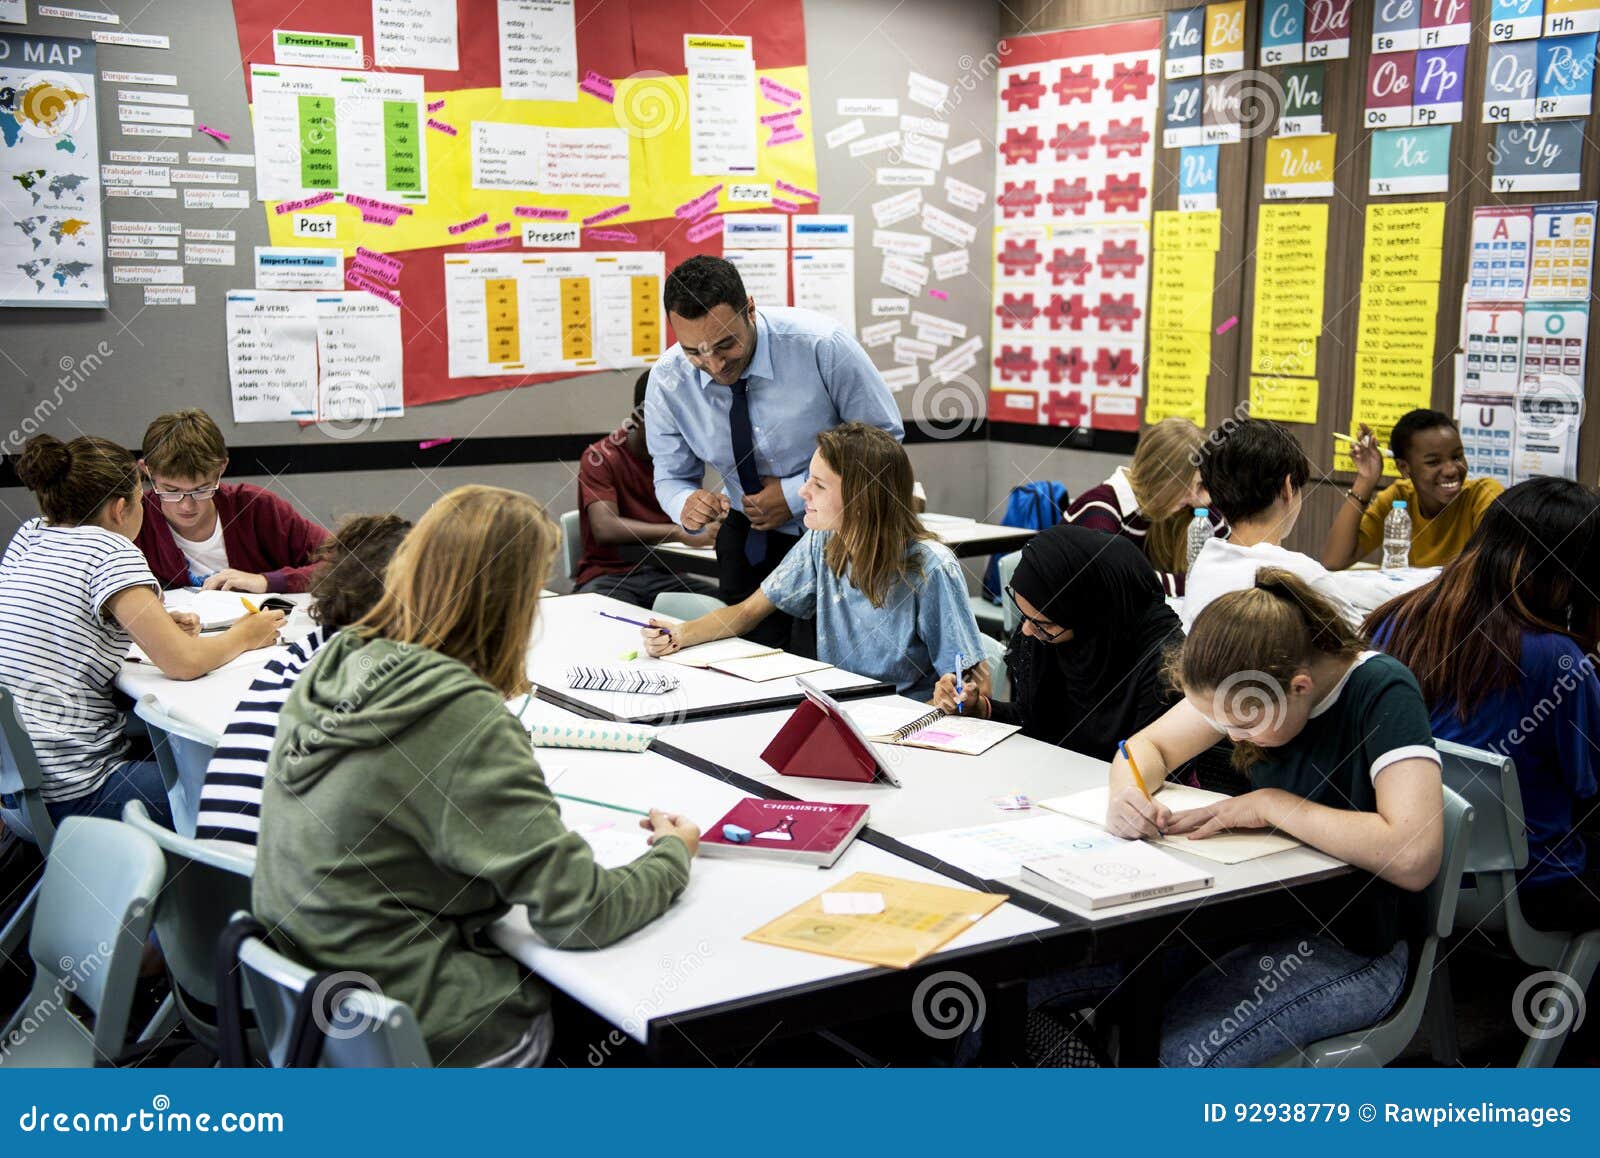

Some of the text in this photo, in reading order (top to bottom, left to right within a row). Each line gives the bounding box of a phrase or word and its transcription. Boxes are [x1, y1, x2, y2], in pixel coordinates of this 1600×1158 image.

[40, 6, 74, 19] Creo que
[1210, 12, 1242, 47] Bb
[1553, 18, 1575, 32] Hh
[1169, 15, 1200, 49] Aa
[1427, 32, 1440, 44] Ff
[1494, 24, 1514, 40] Gg
[285, 36, 349, 48] Preterite Tense
[1378, 37, 1393, 49] Ee
[24, 41, 82, 65] MAP
[1266, 51, 1283, 63] Cc
[1311, 45, 1328, 57] Dd
[1209, 59, 1224, 70] Bb
[103, 72, 130, 82] Porque
[1373, 61, 1409, 97] Oo
[1421, 57, 1458, 101] Pp
[1285, 74, 1321, 110] Nn
[427, 100, 445, 112] Ayer
[1540, 101, 1557, 113] Rr
[1368, 112, 1386, 123] Oo
[1419, 109, 1436, 125] Pp
[1489, 106, 1510, 123] Qq
[428, 118, 458, 136] Anoche
[1285, 121, 1300, 132] Nn
[1207, 131, 1229, 142] Mm
[1394, 137, 1430, 167] Xx
[1523, 127, 1562, 168] Yy
[147, 154, 178, 163] Practical
[103, 166, 142, 177] Trabajador
[216, 172, 237, 182] Funny
[103, 176, 134, 186] working
[1499, 178, 1514, 192] Yy
[106, 188, 129, 196] Genial
[733, 185, 769, 199] Future
[1377, 183, 1391, 193] Xx
[186, 200, 214, 210] Looking
[287, 201, 302, 213] año
[304, 192, 334, 208] pasado
[369, 199, 380, 209] de
[300, 218, 333, 233] Past
[363, 214, 393, 226] pasado
[158, 224, 181, 233] Stupid
[1493, 218, 1509, 240] A
[1549, 217, 1561, 238] E
[137, 237, 154, 247] Ugly
[528, 230, 576, 243] Present
[143, 250, 159, 260] Silly
[186, 255, 223, 265] Dangerous
[260, 257, 325, 266] Imperfect Tense
[114, 275, 153, 284] Disastrous
[145, 296, 182, 306] Disgusting
[266, 305, 290, 313] VERBS
[1488, 314, 1498, 333] I
[1545, 314, 1565, 335] O
[1479, 408, 1494, 428] U
[763, 802, 837, 813] CHEMISTRY
